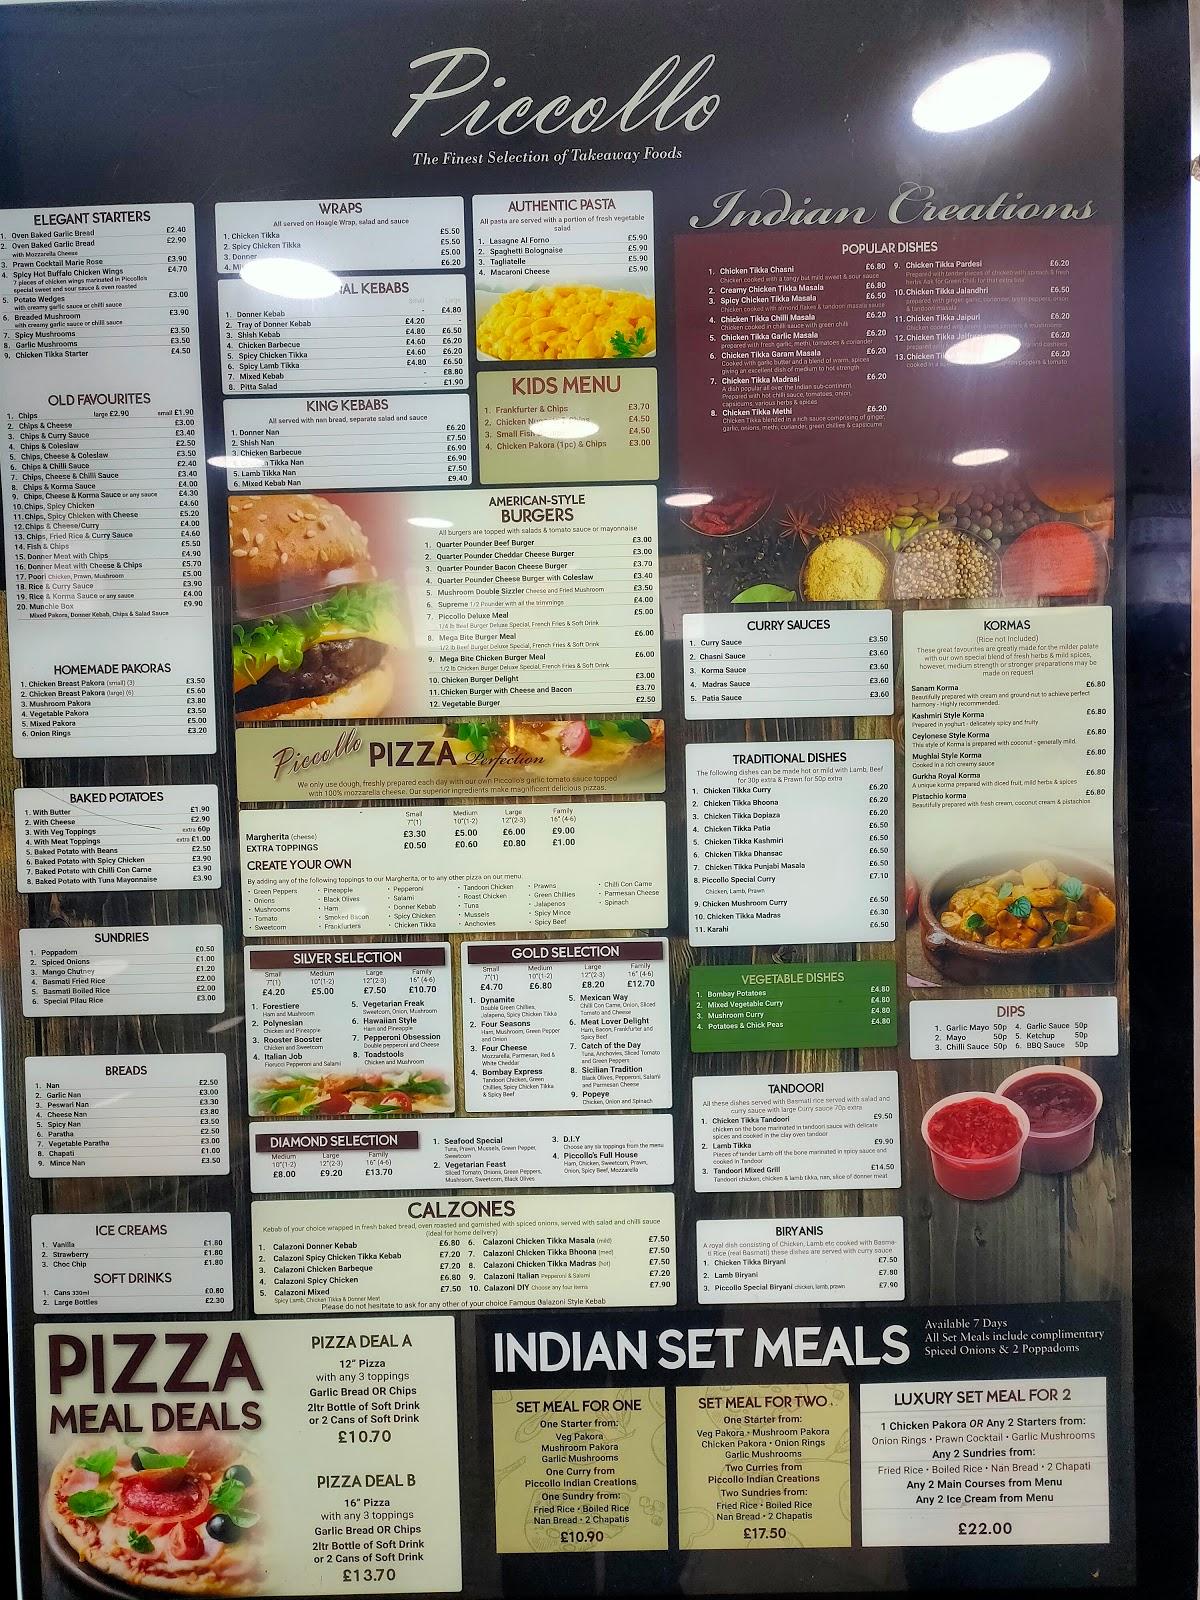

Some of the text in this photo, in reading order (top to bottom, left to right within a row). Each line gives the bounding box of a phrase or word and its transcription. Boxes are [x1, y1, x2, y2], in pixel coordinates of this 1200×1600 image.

[392, 47, 720, 137] Piccollo
[412, 145, 683, 166] The Finest Selection of Takeaway Foods
[318, 201, 363, 216] WRAPS
[507, 197, 617, 213] AUTHENTIC PASTA
[689, 181, 1097, 228] Indian Creations
[33, 210, 151, 226] ELEGANT STARTERS
[489, 233, 649, 246] Lasagne Al Forno £5.90
[841, 241, 939, 255] POPULAR DISHES
[719, 262, 886, 275] Chicken Tikka Chasni £6.80
[361, 281, 411, 295] KEBABS
[263, 309, 286, 318] Kebab
[441, 306, 462, 314] £4.80
[15, 347, 191, 359] Chicken Tikka Starter £4.50
[512, 376, 621, 396] KIDS MENU
[47, 392, 152, 407] OLD FAVOURITES
[306, 398, 389, 413] KING KEBABS
[488, 493, 586, 508] AMERICAN-STYLE
[500, 507, 575, 524] BURGERS
[435, 536, 653, 550] Quarter Pounder Beef Burger £3.00
[746, 619, 831, 632] CURRY SAUCES
[983, 619, 1032, 631] KORMAS
[53, 662, 172, 676] HOMEMADE PAKORAS
[911, 707, 1107, 721] Kashmiri Style Korma £6.80
[29, 726, 208, 739] Onion Rings £3.20
[272, 728, 544, 780] Piccollo PIZZA Perfection
[732, 751, 847, 765] TRADITIONAL DISHES
[703, 783, 889, 795] Chicken Tikka Curry £6.20
[69, 791, 164, 805] BAKED POTATOES
[245, 832, 290, 843] Margherita
[403, 826, 575, 838] £3.30 £5.00 £6.00 £9.00
[33, 838, 50, 846] With
[69, 837, 101, 847] Toppings
[246, 843, 319, 854] EXTRA TOPPINGS
[246, 858, 352, 872] CREATE YOUR OWN
[94, 931, 150, 943] SUNDRIES
[292, 950, 403, 965] SILVER SELECTION
[511, 945, 621, 960] GOLD SELECTION
[42, 975, 216, 986] Basmati Fried Rice £2.00
[741, 971, 845, 985] VEGETABLE DISHES
[997, 1005, 1026, 1018] DIPS
[707, 1023, 739, 1031] Potatoes
[745, 1021, 766, 1029] Chick
[766, 1021, 784, 1029] Peas
[871, 1017, 891, 1025] £4.80
[1026, 1031, 1089, 1041] Ketchup 50p
[581, 1041, 642, 1051] Catch of the Day
[105, 1065, 148, 1076] BREADS
[482, 1067, 543, 1078] Bombay Express
[767, 1082, 825, 1095] TANDOORI
[47, 1137, 221, 1150] Vegetable Paratha £3.00
[270, 1134, 398, 1149] DIAMOND SELECTION
[408, 1201, 515, 1219] CALZONES
[95, 1224, 168, 1237] ICE CREAMS
[774, 1225, 825, 1238] BIRYANIS
[272, 1239, 461, 1251] Calazoni Donner Kebab £6.80
[93, 1272, 173, 1285] SOFT DRINKS
[925, 1318, 1008, 1330] Available 7 Days
[311, 1333, 413, 1350] PIZZA DEAL A
[925, 1327, 1104, 1343] All Set Meals include complimentary
[495, 1325, 910, 1372] INDIAN SET MEALS
[925, 1342, 1080, 1358] Spiced Onions & 2 Poppadoms
[49, 1332, 264, 1395] PIZZA
[315, 1371, 410, 1384] with any 3 toppings
[309, 1385, 418, 1398] Garlic Bread OR Chips
[894, 1388, 1072, 1406] LUXURY SET MEAL FOR 2
[515, 1399, 642, 1414] SET MEAL FOR ONE
[698, 1396, 723, 1410] SET
[725, 1396, 763, 1410] MEAL
[764, 1395, 793, 1409] FOR
[50, 1401, 262, 1434] MEAL DEALS
[337, 1429, 392, 1444] £10.70
[316, 1473, 417, 1489] PIZZA DEAL B
[906, 1477, 1063, 1492] Any 2 Main Courses from Menu
[743, 1527, 787, 1540] £17.50
[957, 1521, 1013, 1537] £22.00
[560, 1530, 604, 1543] £10.90
[342, 1568, 396, 1583] £13.70
